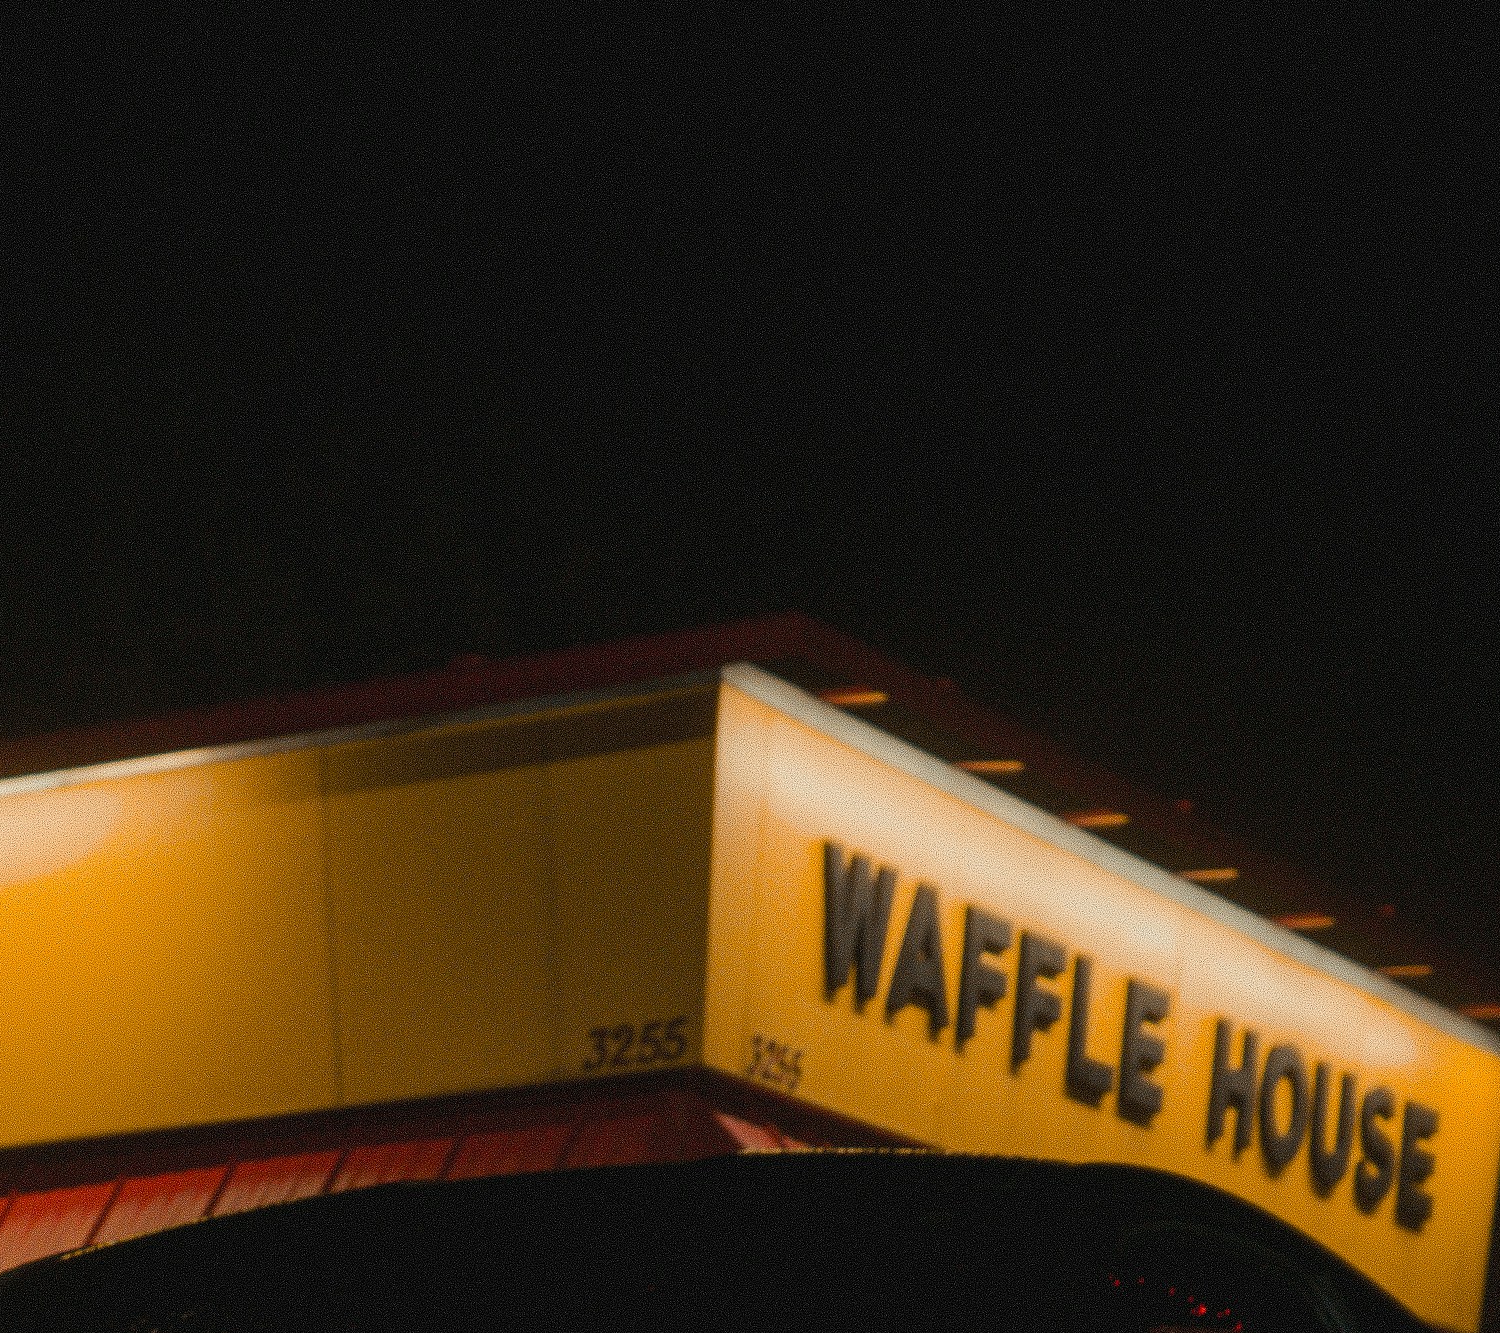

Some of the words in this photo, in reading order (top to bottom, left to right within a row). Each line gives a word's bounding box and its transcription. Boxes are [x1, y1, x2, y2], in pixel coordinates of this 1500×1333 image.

[583, 1015, 688, 1070] 3255
[822, 842, 1170, 1129] WAFFLE
[1203, 1016, 1439, 1235] HOUSE
